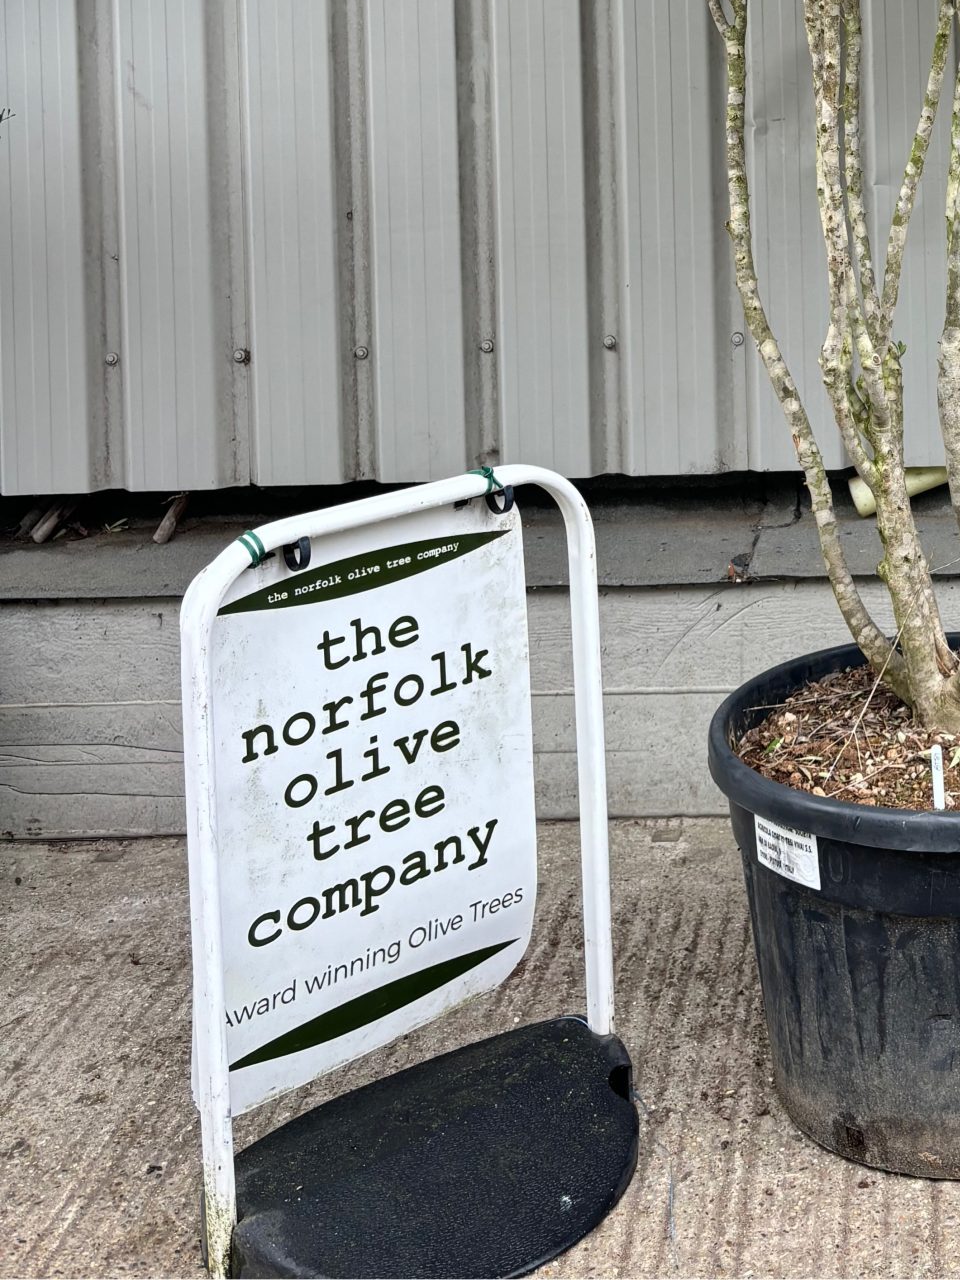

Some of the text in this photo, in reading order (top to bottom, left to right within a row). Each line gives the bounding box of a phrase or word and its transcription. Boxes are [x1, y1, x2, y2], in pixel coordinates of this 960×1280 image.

[267, 541, 460, 604] the norfolk olive tree company
[316, 615, 420, 671] the
[241, 642, 493, 764] norfolk
[283, 720, 461, 809] olive
[306, 785, 446, 861] tree
[246, 818, 499, 948] company
[304, 939, 402, 995] winning
[408, 913, 463, 949] Olive
[469, 886, 524, 923] Trees
